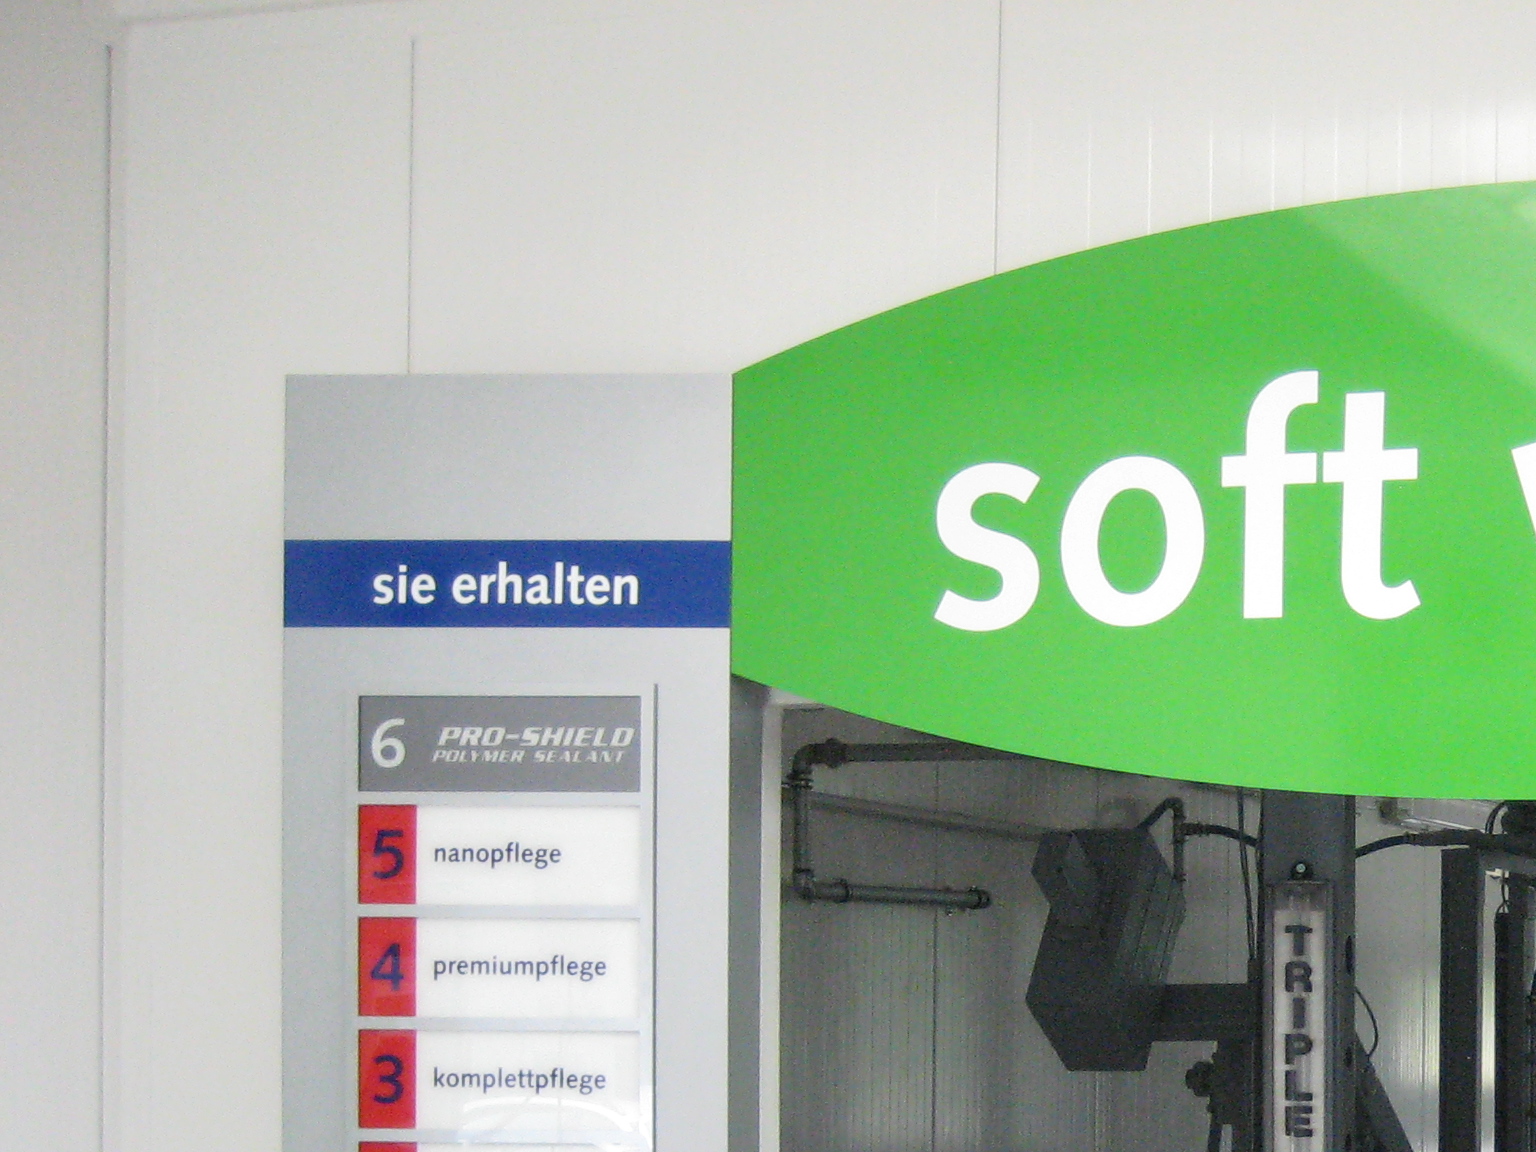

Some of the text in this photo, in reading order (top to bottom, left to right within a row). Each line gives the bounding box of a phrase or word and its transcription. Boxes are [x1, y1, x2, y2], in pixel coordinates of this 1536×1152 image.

[934, 370, 1421, 632] soft
[372, 561, 639, 605] sie erhalten
[371, 718, 635, 768] 6 PRO-SHIELD
[432, 750, 625, 762] POLYMER SEALANT
[372, 830, 561, 880] 5 nanopflege
[370, 943, 606, 991] 4 premiumpflege
[1284, 924, 1313, 1138] TRIPLE
[373, 1055, 606, 1104] 3 komplettpflege
